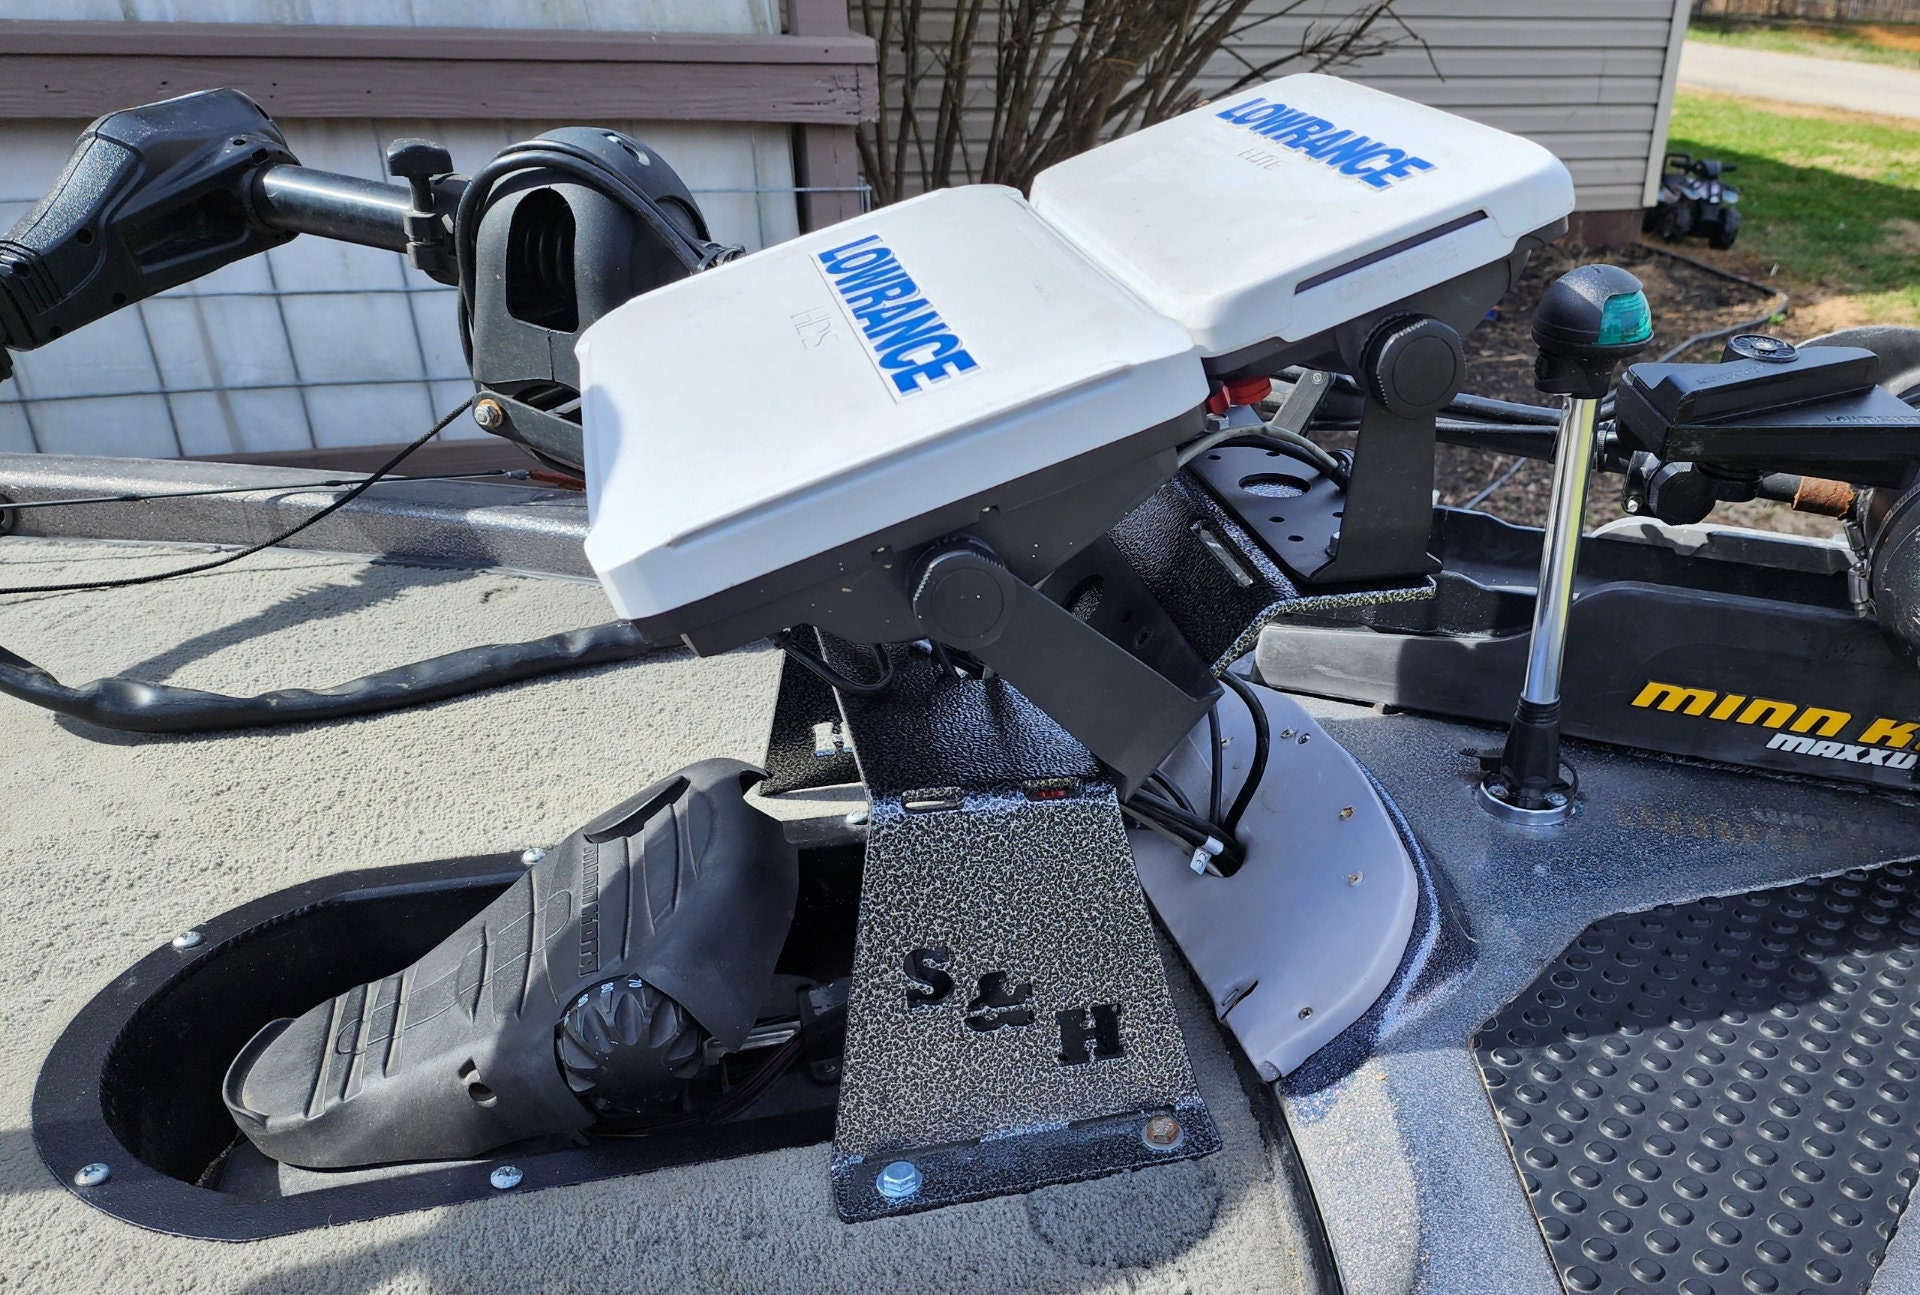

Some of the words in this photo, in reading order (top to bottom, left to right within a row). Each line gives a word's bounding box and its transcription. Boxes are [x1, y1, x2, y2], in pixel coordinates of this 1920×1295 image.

[1215, 97, 1437, 191] LOWRANCE
[790, 305, 840, 350] HDS
[817, 234, 981, 396] LOWRANCE
[1631, 681, 1852, 737] MINN
[1857, 717, 1920, 749] K
[1765, 733, 1919, 770] MAXXU
[579, 905, 599, 977] KOTA
[601, 982, 614, 993] 80
[628, 978, 643, 988] 70
[903, 947, 956, 1008] S
[1055, 1003, 1126, 1067] H
